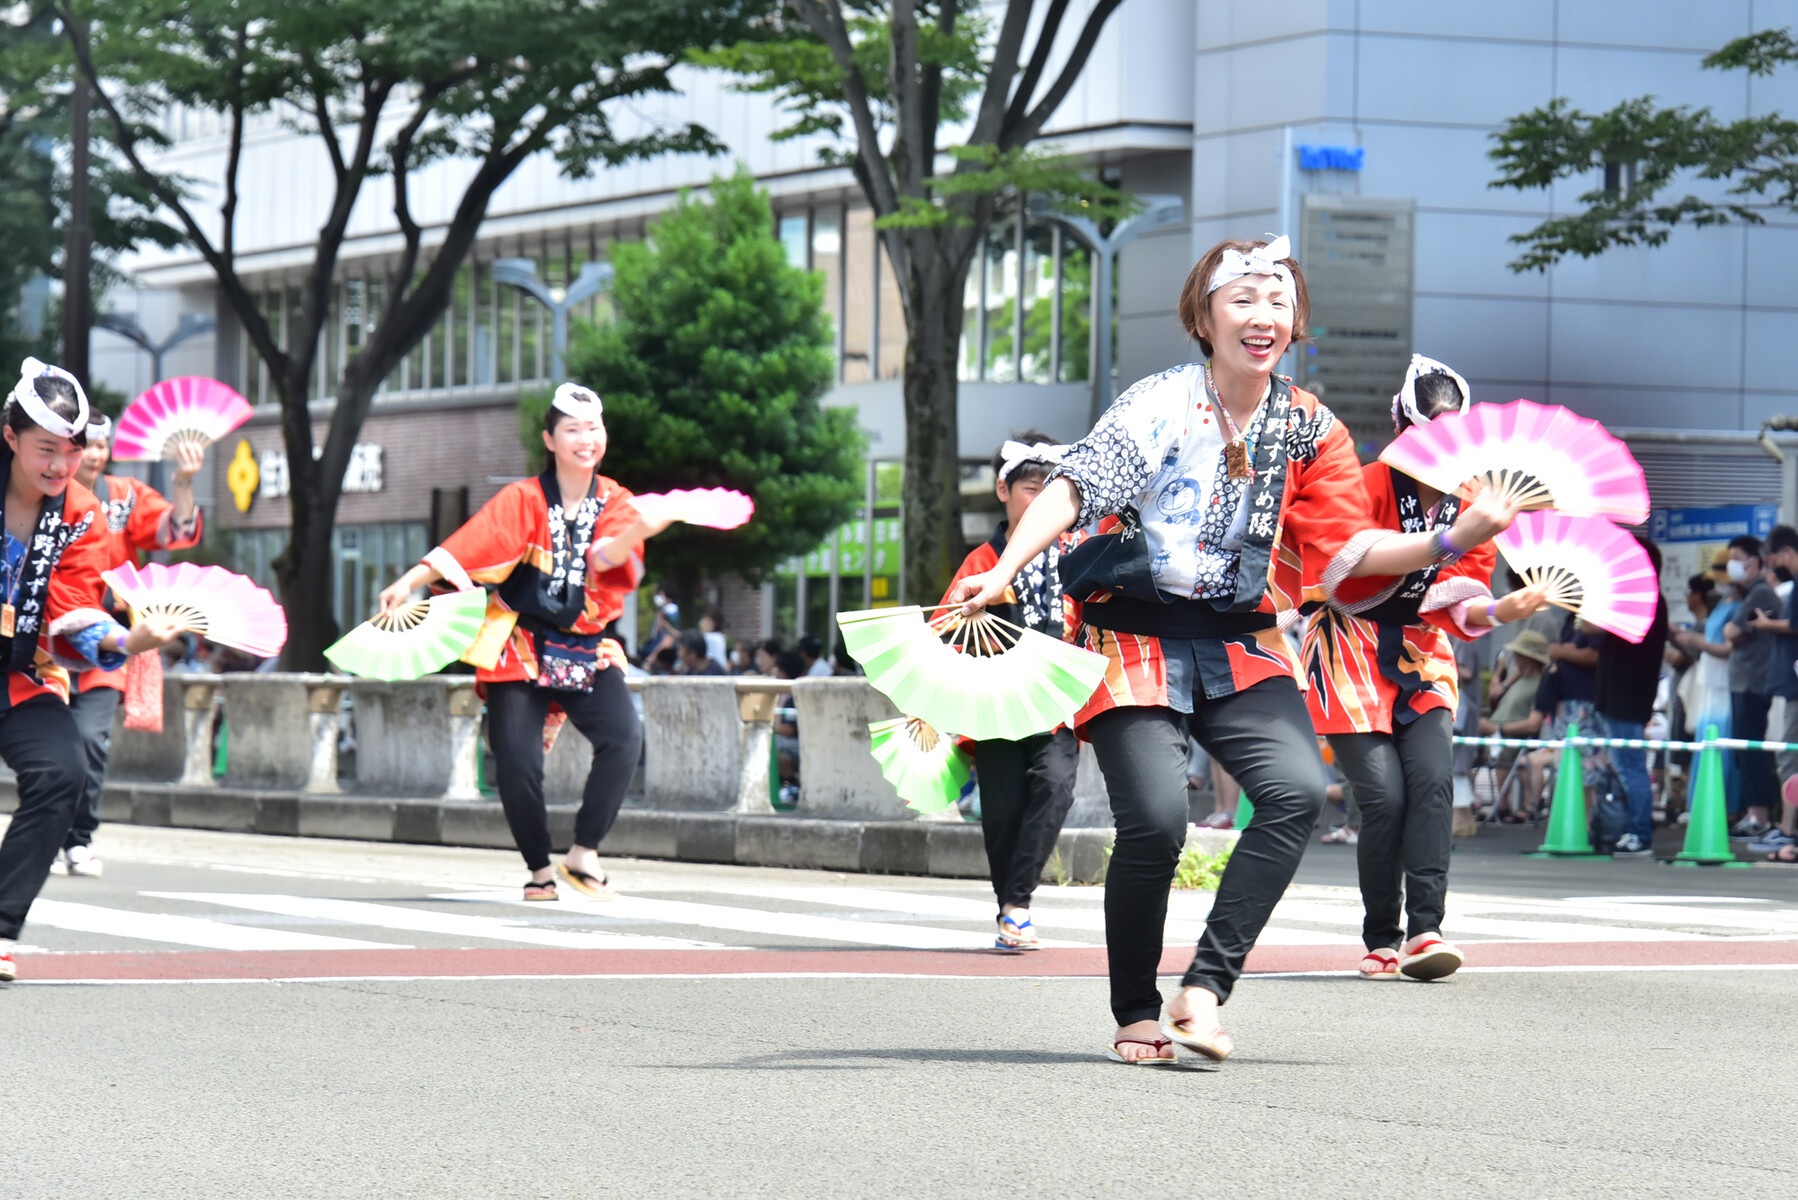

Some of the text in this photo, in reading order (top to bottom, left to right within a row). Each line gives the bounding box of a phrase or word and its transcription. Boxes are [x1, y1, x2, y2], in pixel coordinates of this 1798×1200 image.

[1249, 393, 1291, 538] 沖野すずめ隊
[16, 511, 61, 633] 沖野すずめ隊
